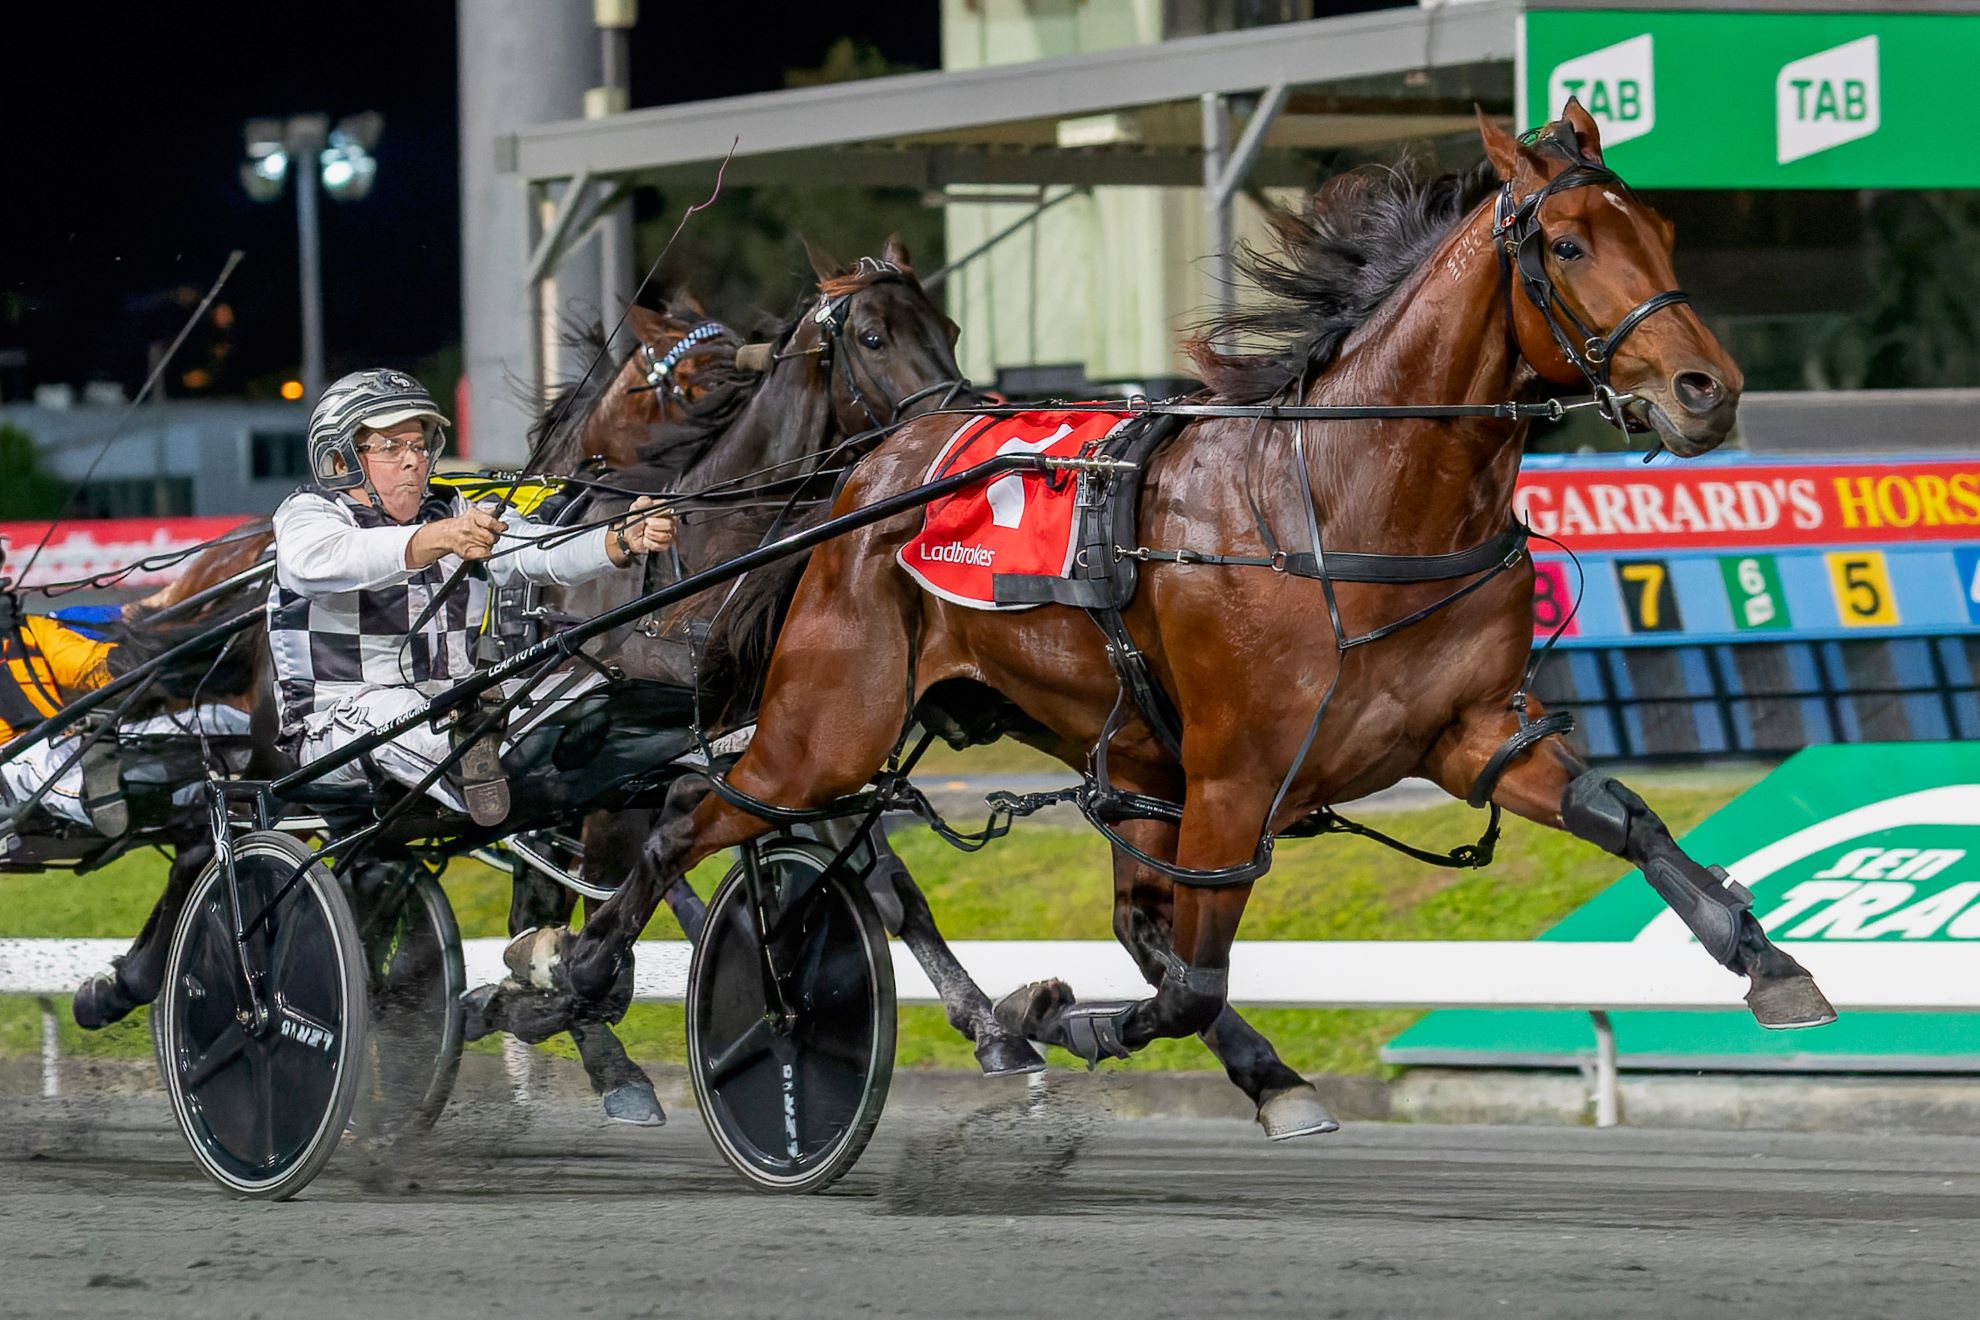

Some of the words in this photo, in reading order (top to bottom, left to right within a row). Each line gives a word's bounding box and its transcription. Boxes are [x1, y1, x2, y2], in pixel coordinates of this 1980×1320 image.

[1562, 80, 1642, 121] TAB
[1789, 79, 1867, 121] TAB
[1513, 478, 1824, 537] GARRARD'S
[920, 541, 995, 567] Ladbrokes
[1621, 564, 1665, 628] 7
[1843, 561, 1880, 616] 5
